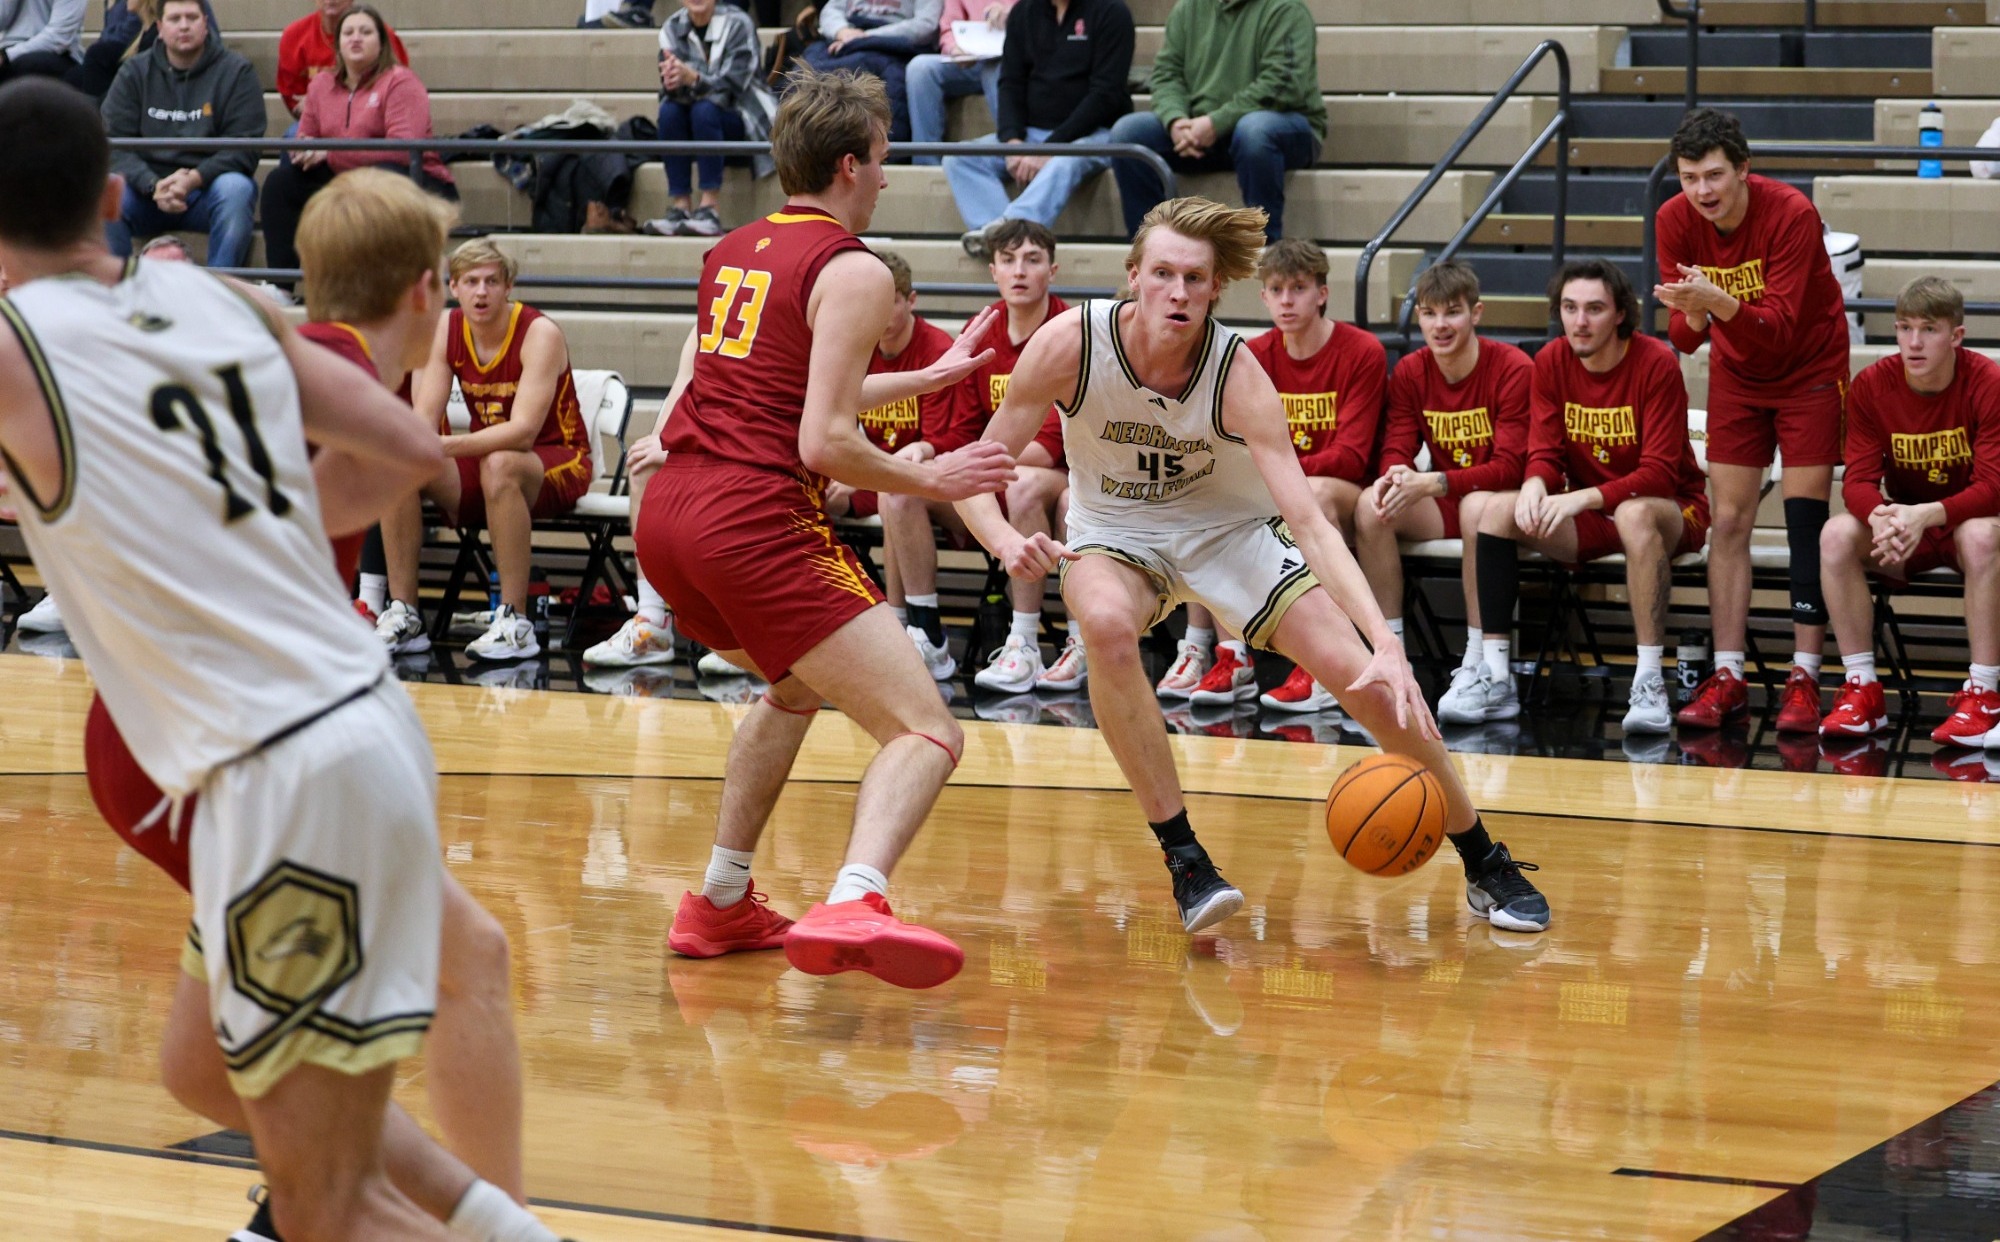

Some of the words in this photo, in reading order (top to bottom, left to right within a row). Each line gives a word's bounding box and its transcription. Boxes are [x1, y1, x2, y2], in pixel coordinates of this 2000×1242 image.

[1701, 263, 1764, 295] IMPSON
[699, 265, 772, 359] 33
[1281, 396, 1336, 420] MPSON
[148, 362, 292, 526] 21
[1893, 430, 1969, 461] SIMPSON
[1138, 450, 1185, 481] 45
